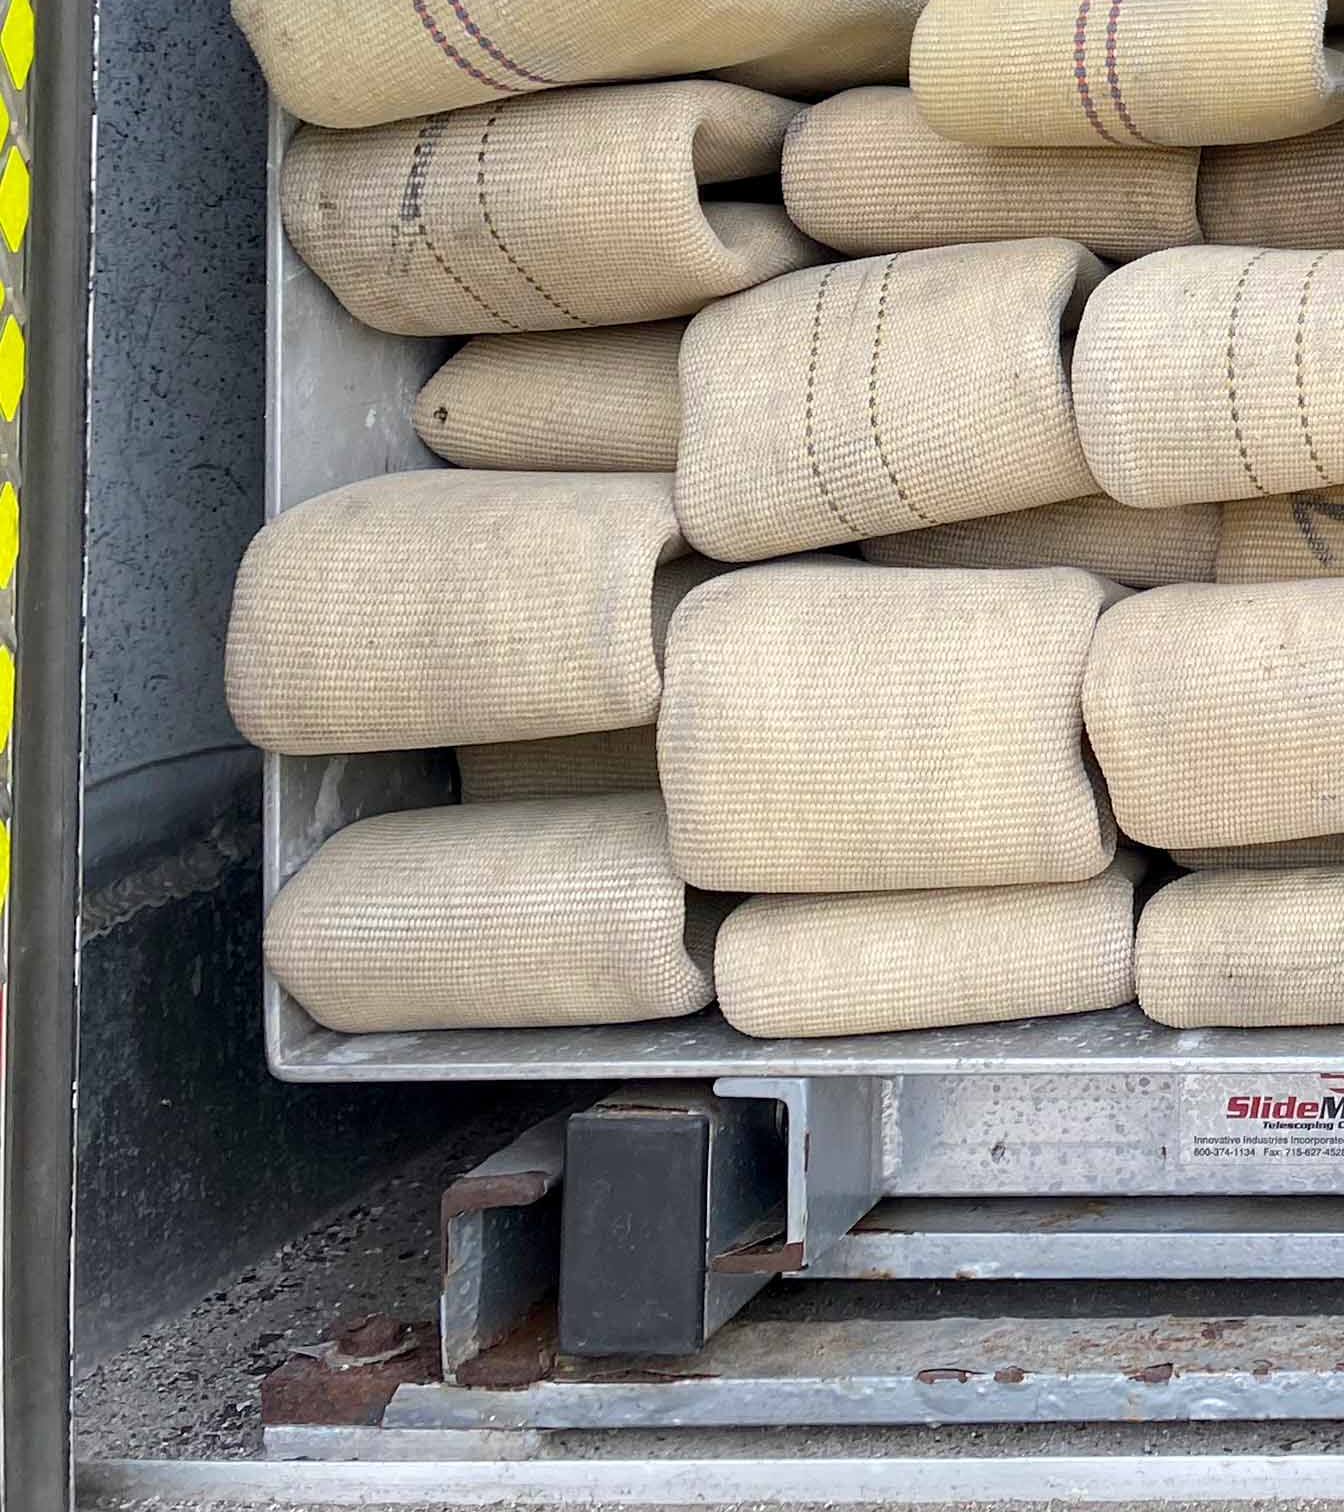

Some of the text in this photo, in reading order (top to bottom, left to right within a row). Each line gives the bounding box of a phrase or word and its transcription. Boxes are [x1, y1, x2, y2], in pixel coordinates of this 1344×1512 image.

[1262, 1120, 1335, 1132] Telescoping
[1193, 1135, 1241, 1145] Innovative
[1243, 1135, 1288, 1145] Industries
